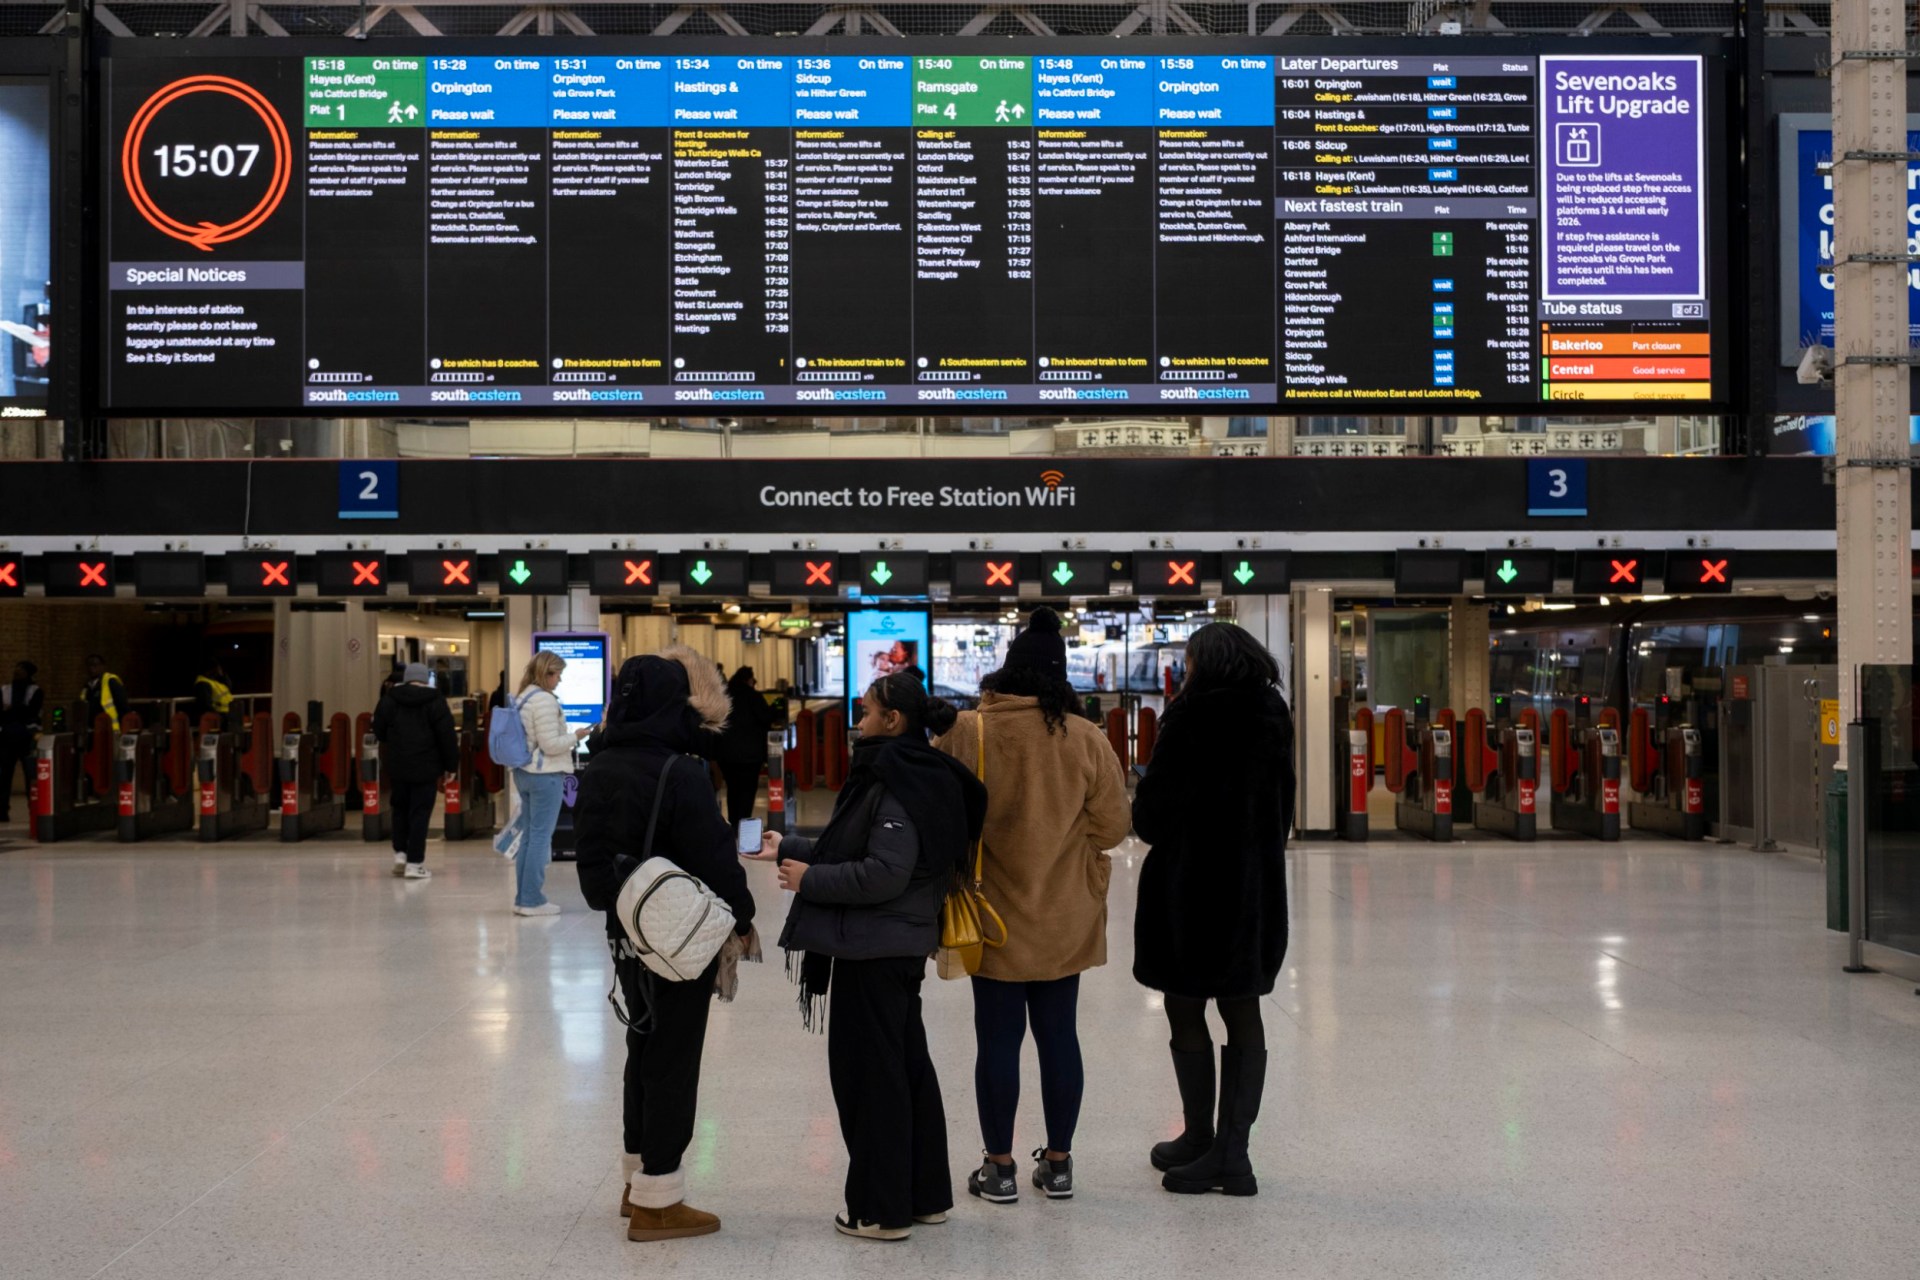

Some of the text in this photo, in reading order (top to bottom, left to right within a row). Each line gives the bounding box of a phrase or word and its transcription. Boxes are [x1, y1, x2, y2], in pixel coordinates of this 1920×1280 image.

[311, 60, 345, 70] 15:18
[373, 60, 418, 70] On time
[433, 60, 466, 70] 15:28
[495, 60, 539, 70] On time
[554, 59, 586, 70] 15:31
[616, 60, 661, 69] On time
[676, 59, 710, 69] 15:34
[738, 59, 782, 69] On time
[798, 59, 830, 69] 15:36
[859, 59, 904, 69] On time
[918, 59, 952, 69] 15:40
[980, 59, 1024, 69] On time
[1040, 59, 1073, 69] 15:48
[1101, 59, 1145, 69] On time
[1160, 59, 1194, 69] 15:58
[1222, 59, 1266, 69] On time
[1282, 58, 1398, 72] Later Departures
[1433, 63, 1448, 71] Plat
[310, 74, 375, 86] Hayes (Kent)
[553, 74, 605, 86] Orpington
[796, 74, 831, 85] Sidcup
[1038, 74, 1103, 85] Hayes (Kent)
[1282, 79, 1309, 88] 16:01
[1315, 79, 1362, 90] Orpington
[1433, 78, 1451, 86] wait
[1556, 71, 1676, 90] Sevenoaks
[432, 82, 492, 95] Orpington
[675, 82, 738, 95] Hastings &
[918, 81, 978, 95] Ramsgate
[1159, 81, 1219, 94] Orpington
[310, 89, 387, 99] via Catford Bridge
[568, 89, 594, 97] Grove
[596, 89, 615, 97] Park
[811, 89, 838, 97] Hither
[839, 89, 866, 97] Green
[1052, 88, 1085, 96] Catford
[1086, 88, 1115, 98] Bridge
[918, 103, 957, 120] Plat 4
[1557, 95, 1689, 118] Lift Upgrade
[310, 104, 344, 120] Plat 1
[432, 110, 494, 120] Please wait
[553, 109, 616, 119] Please wait
[675, 109, 737, 119] Please wait
[796, 109, 858, 119] Please wait
[1039, 109, 1100, 119] Please wait
[1160, 108, 1221, 118] Please wait
[1282, 110, 1310, 119] 16:04
[1315, 110, 1365, 121] Hastings &
[1283, 141, 1310, 149] 16:06
[1315, 141, 1347, 152] Sidcup
[1433, 139, 1452, 147] wait
[154, 145, 259, 176] 15:07
[711, 158, 728, 167] East
[765, 159, 788, 167] 15:37
[1283, 172, 1311, 180] 16:18
[1316, 171, 1375, 182] Hayes (Kent)
[1434, 170, 1452, 178] wait
[1285, 199, 1402, 212] Next fastest train
[1435, 206, 1449, 214] Plat
[1558, 217, 1581, 226] 2026.
[127, 268, 246, 285] Special Notices
[918, 271, 958, 280] Ramsgate
[1008, 270, 1031, 278] 18:02
[675, 277, 699, 285] Battle
[765, 277, 788, 285] 17:20
[127, 304, 244, 314] In the interests of station
[1542, 302, 1622, 314] Tube status
[126, 320, 257, 332] security please do not leave
[675, 324, 710, 334] Hastings
[126, 337, 275, 348] luggage unattended at any time
[1552, 340, 1603, 350] Bakerloo
[1633, 342, 1681, 350] Part closure
[126, 353, 215, 364] See it Say it Sorted
[1285, 352, 1312, 361] Sidcup
[1552, 365, 1593, 374] Central
[309, 390, 399, 401] southeastern
[431, 389, 521, 401] southeastern
[553, 389, 643, 400] southeastern
[675, 388, 764, 400] southeastern
[797, 388, 886, 400] southeastern
[918, 388, 1007, 400] southeastern
[1040, 388, 1128, 399] southeastern
[1161, 387, 1249, 399] southeastern
[1553, 391, 1585, 400] Circle
[359, 471, 378, 499] 2
[1549, 469, 1567, 497] 3
[760, 486, 1075, 506] Connect to Free Station WiFi
[745, 630, 752, 639] 2
